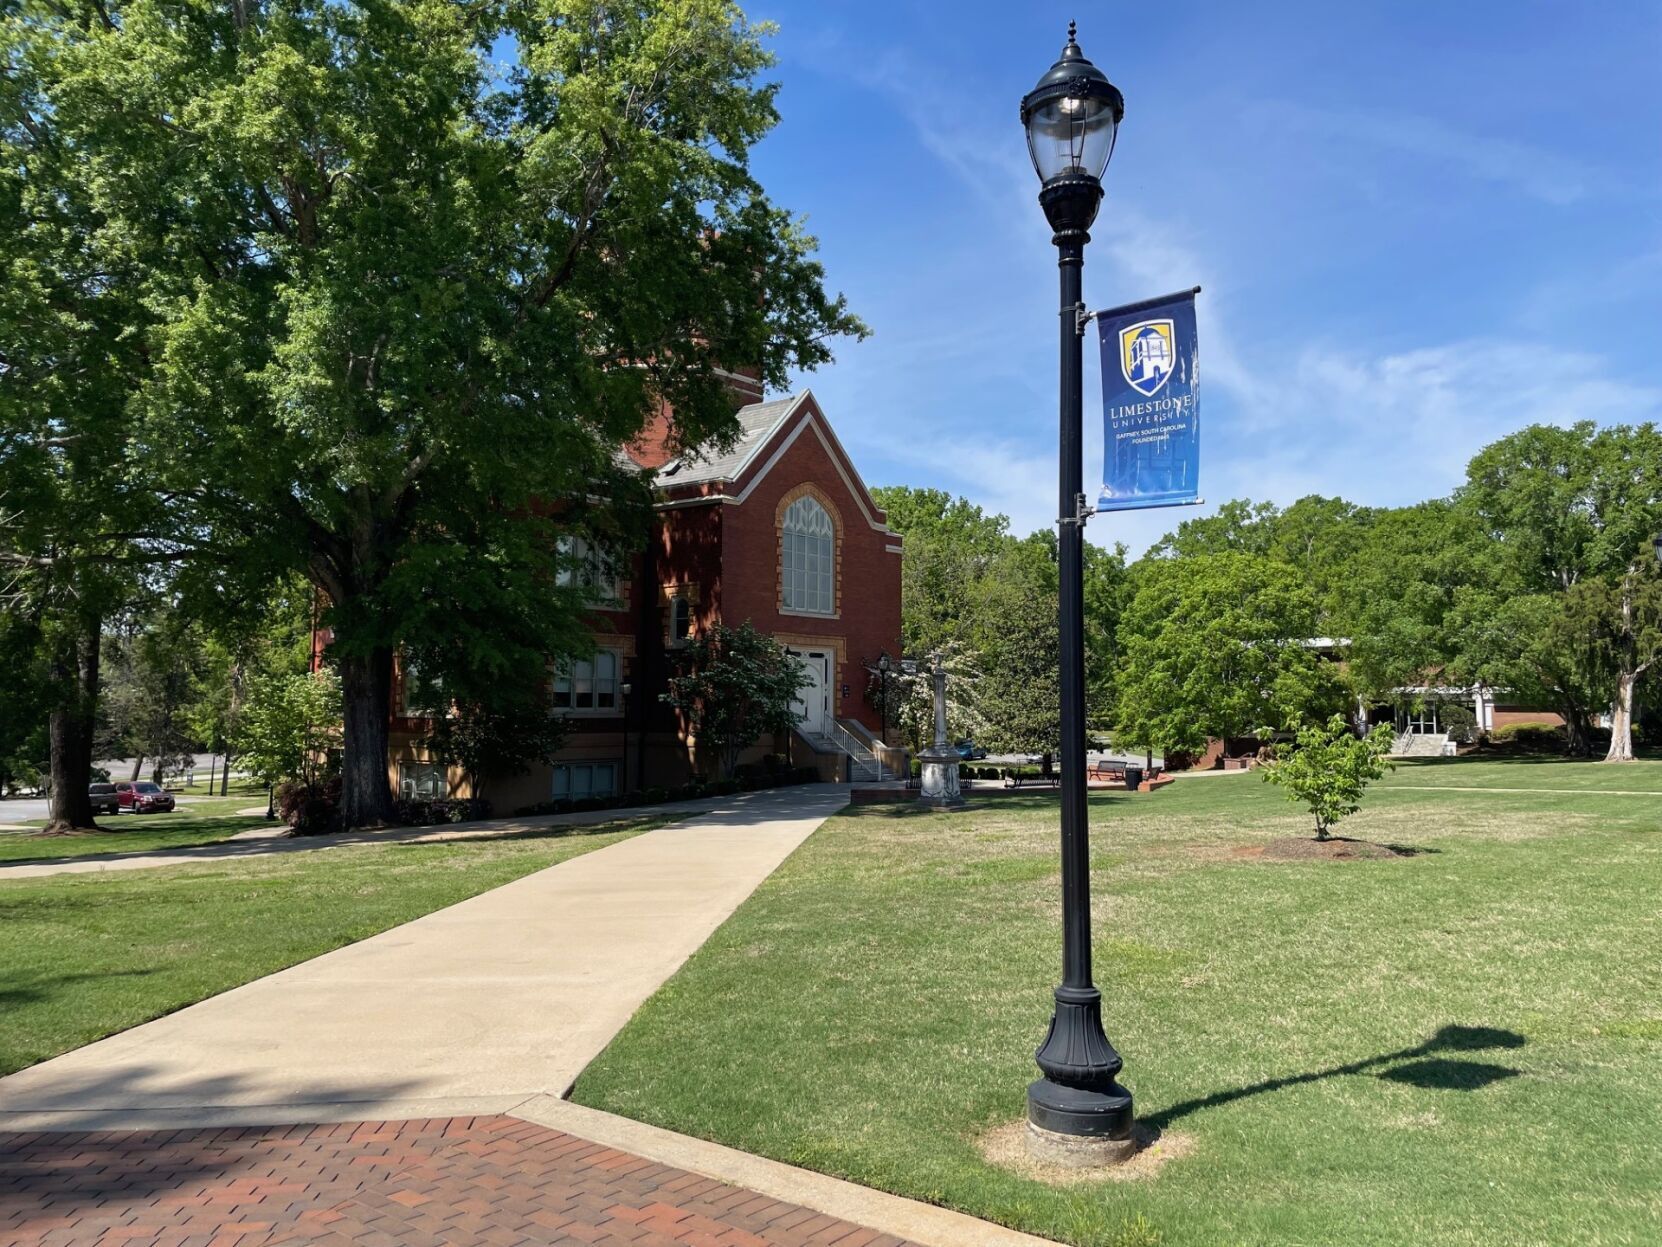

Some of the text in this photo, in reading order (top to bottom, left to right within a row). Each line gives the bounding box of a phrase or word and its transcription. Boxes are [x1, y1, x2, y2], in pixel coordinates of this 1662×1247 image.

[1110, 395, 1192, 419] LIMESTONE
[1112, 409, 1190, 429] UNIVERSIY
[1141, 427, 1159, 436] SOUTH
[1160, 423, 1186, 433] CAROLINA
